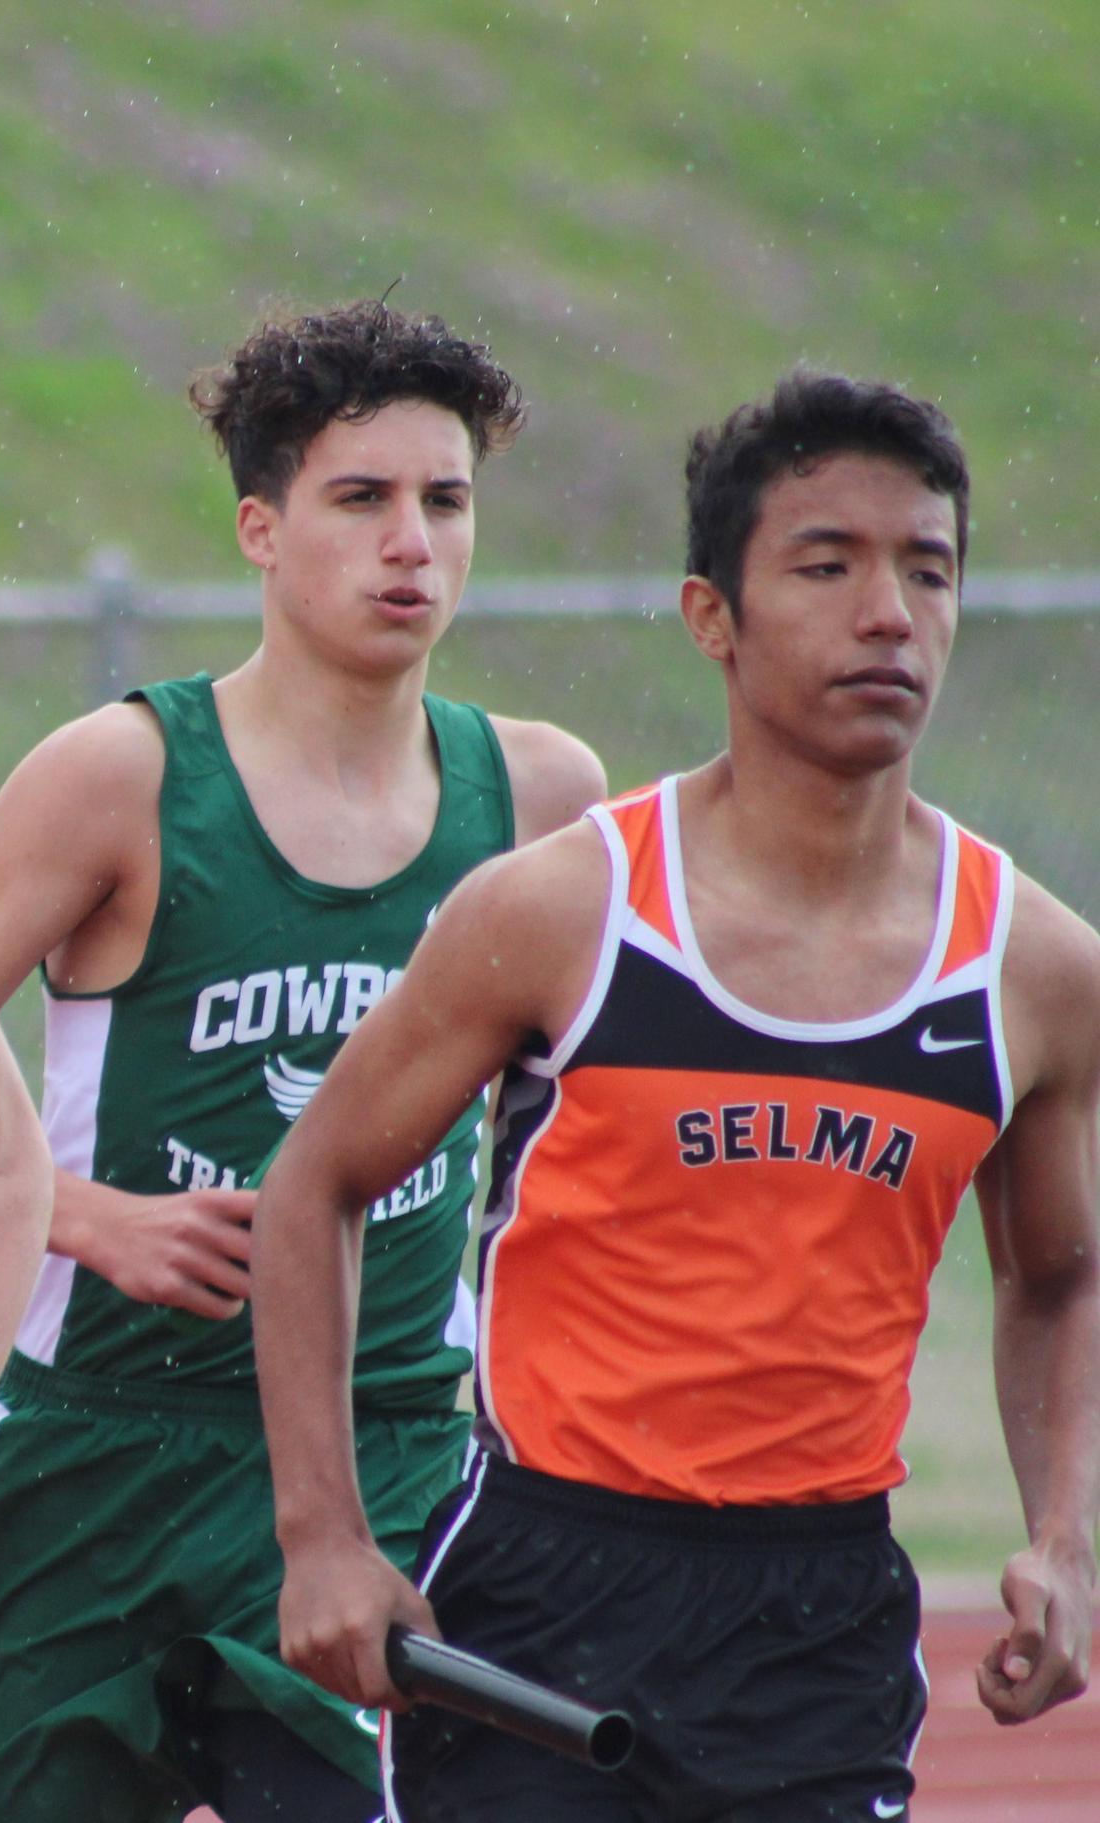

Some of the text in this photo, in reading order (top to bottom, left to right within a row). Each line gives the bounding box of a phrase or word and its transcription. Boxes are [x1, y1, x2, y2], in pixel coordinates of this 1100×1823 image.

[189, 962, 405, 1053] COWB
[166, 1136, 250, 1192] TRA
[675, 1103, 917, 1192] SELMA
